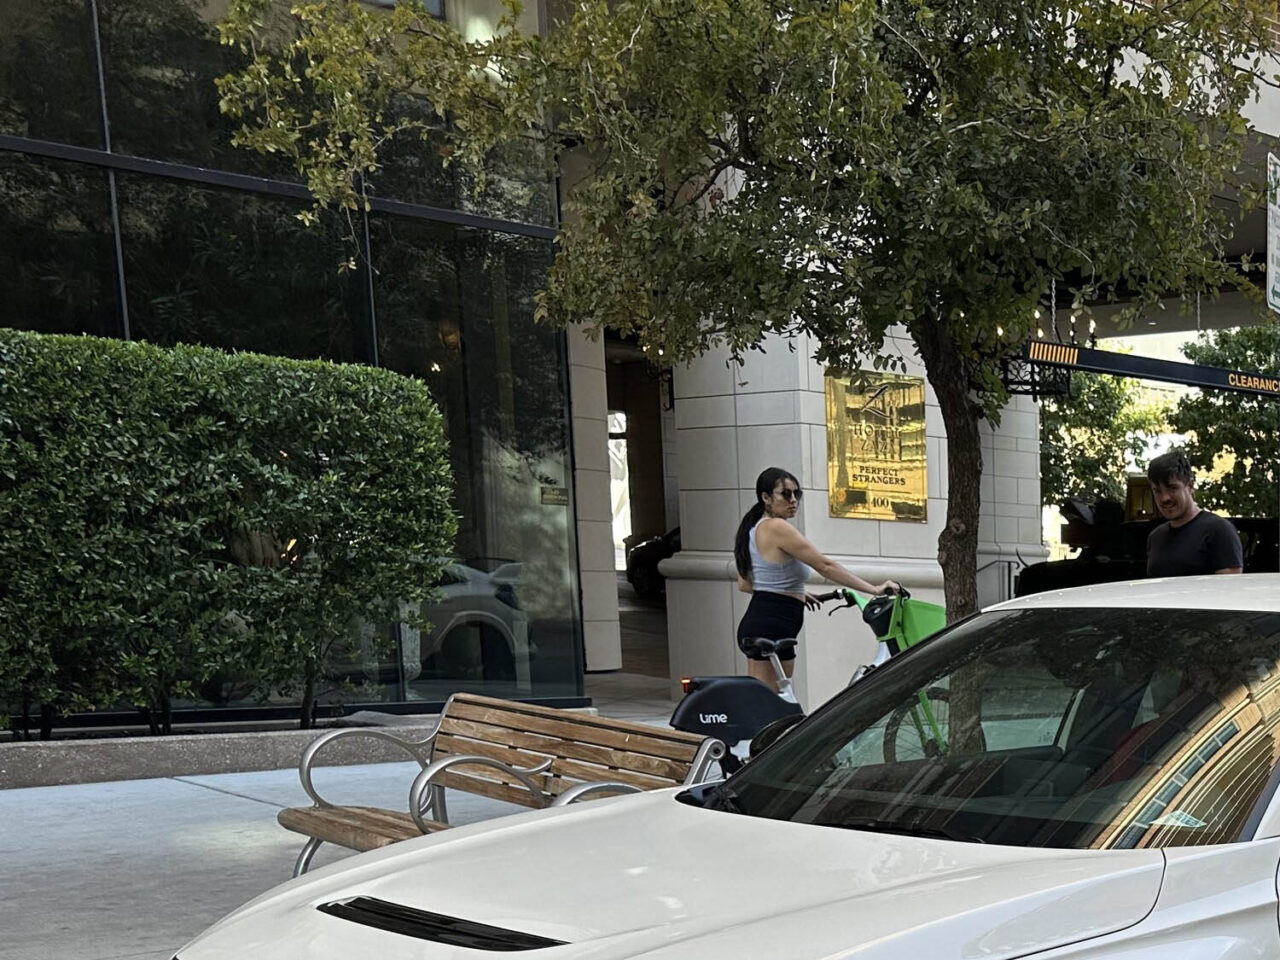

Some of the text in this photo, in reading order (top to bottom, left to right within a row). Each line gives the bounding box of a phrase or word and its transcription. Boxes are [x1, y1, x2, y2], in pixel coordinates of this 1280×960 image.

[1228, 373, 1280, 392] CLEARANC
[859, 465, 899, 477] PERFECT
[852, 473, 906, 486] STRANGERS
